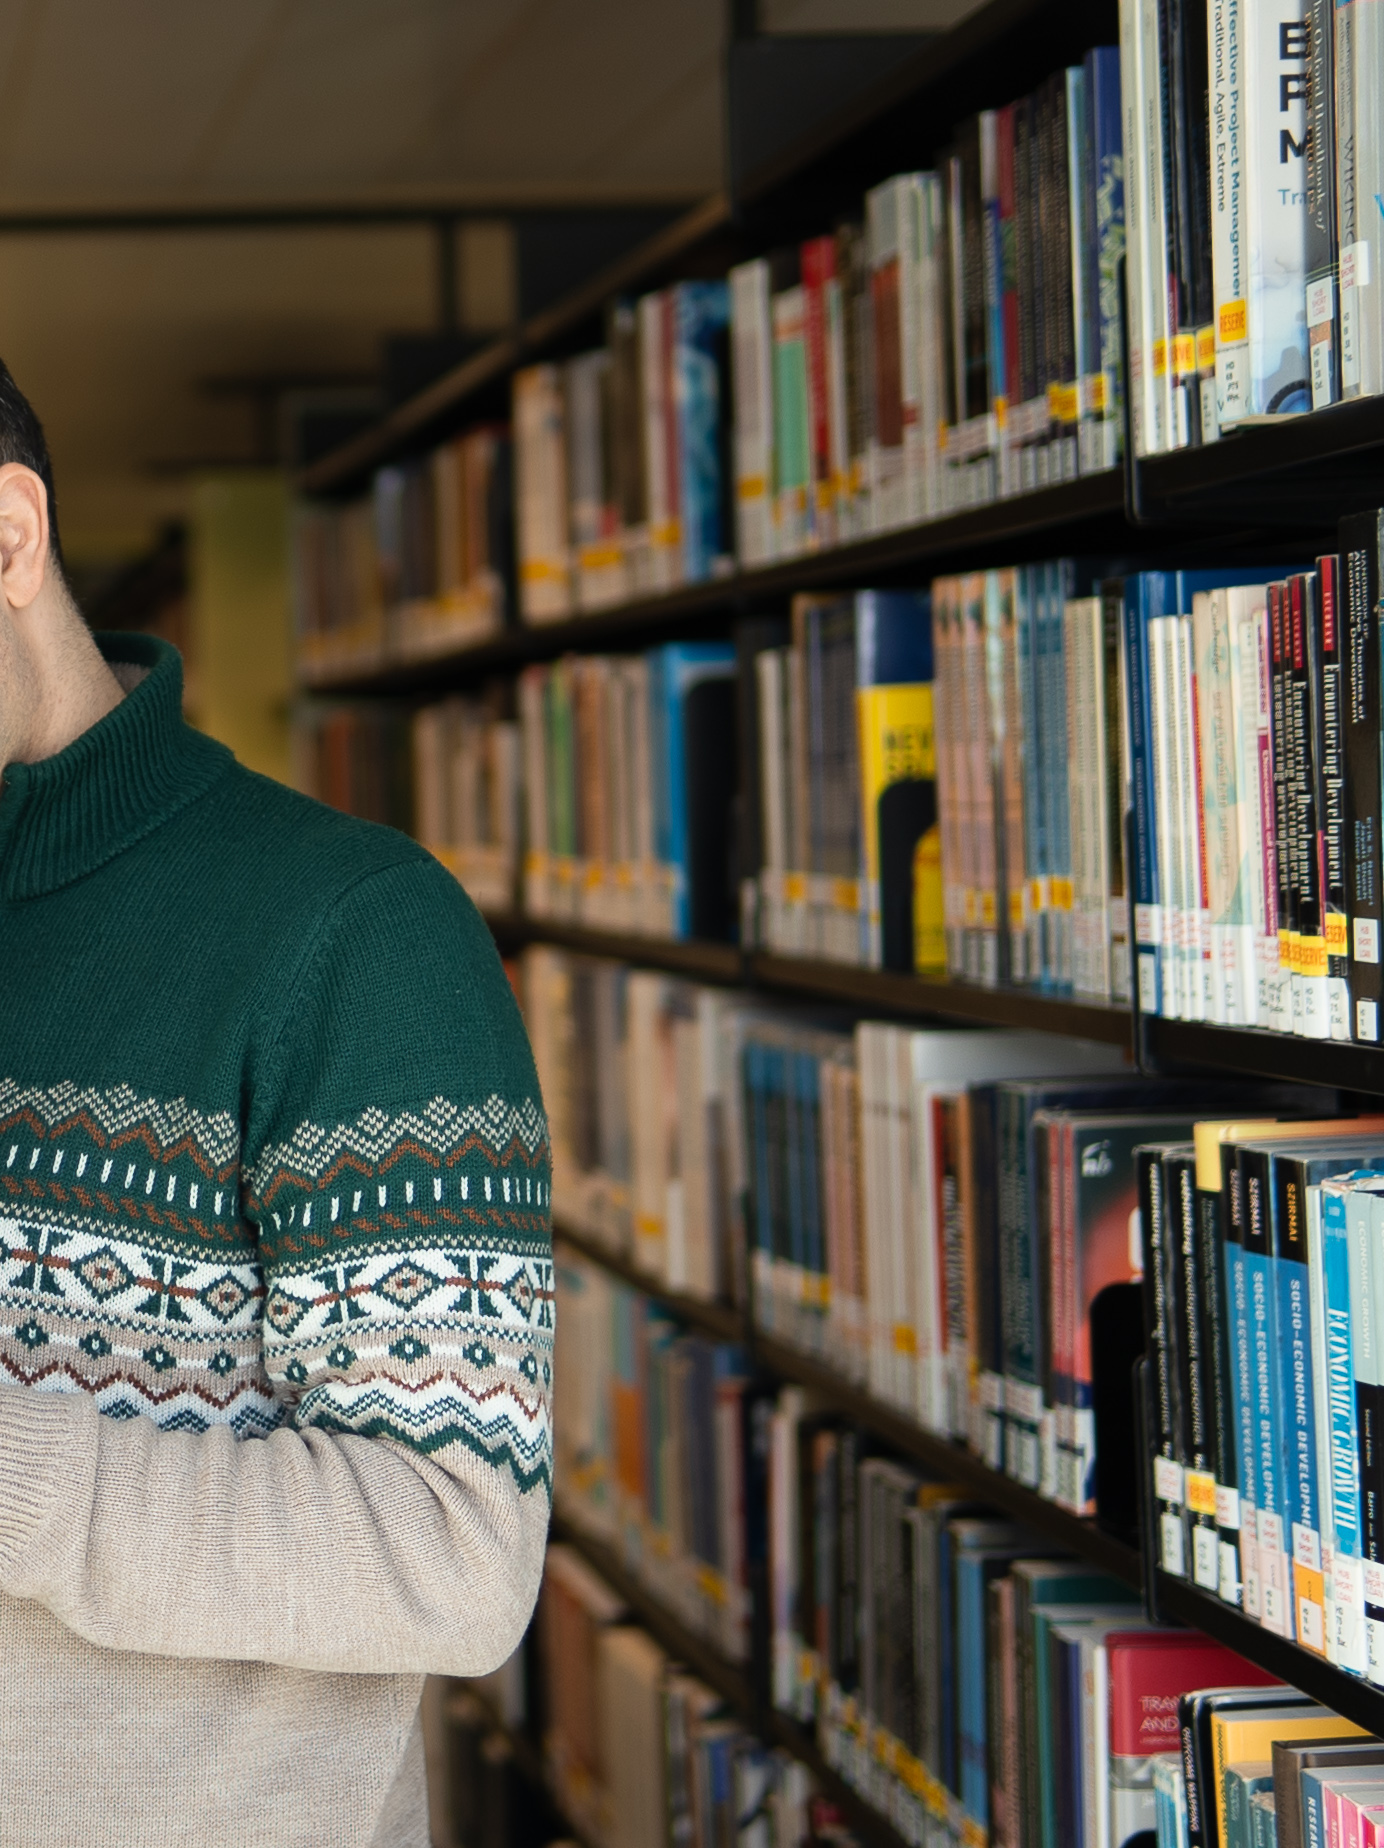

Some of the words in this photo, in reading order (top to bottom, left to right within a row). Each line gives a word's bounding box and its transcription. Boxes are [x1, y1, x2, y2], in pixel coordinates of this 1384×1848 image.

[1228, 0, 1239, 85] ffective
[1314, 28, 1325, 98] Oxford
[1214, 92, 1226, 139] Agile,
[1228, 90, 1240, 167] Project
[1216, 142, 1227, 212] Extreme
[1315, 102, 1326, 206] Handbook
[1315, 210, 1327, 234] of
[1347, 552, 1356, 624] Economic
[1354, 550, 1362, 633] Alternative
[1349, 627, 1358, 724] Development
[1356, 636, 1364, 702] Theories
[1323, 663, 1344, 775] Encountering
[1358, 705, 1367, 720] of
[1323, 778, 1345, 890] Development
[1248, 1177, 1262, 1236] SZIRMAI
[1286, 1182, 1298, 1243] SZIRMAI
[1357, 1219, 1367, 1294] ECONOMIC
[1253, 1271, 1269, 1415] SOCIO-ECONOMIC
[1290, 1278, 1306, 1426] SOCIO-ECONOMIC
[1361, 1297, 1371, 1359] GROWTH
[1327, 1308, 1352, 1426] ECONOMIC
[1332, 1429, 1356, 1531] GROWTH
[1367, 1491, 1376, 1519] Barro
[1335, 1578, 1354, 1592] SHORT
[1336, 1592, 1353, 1604] LOAN
[1337, 1568, 1351, 1579] HUB
